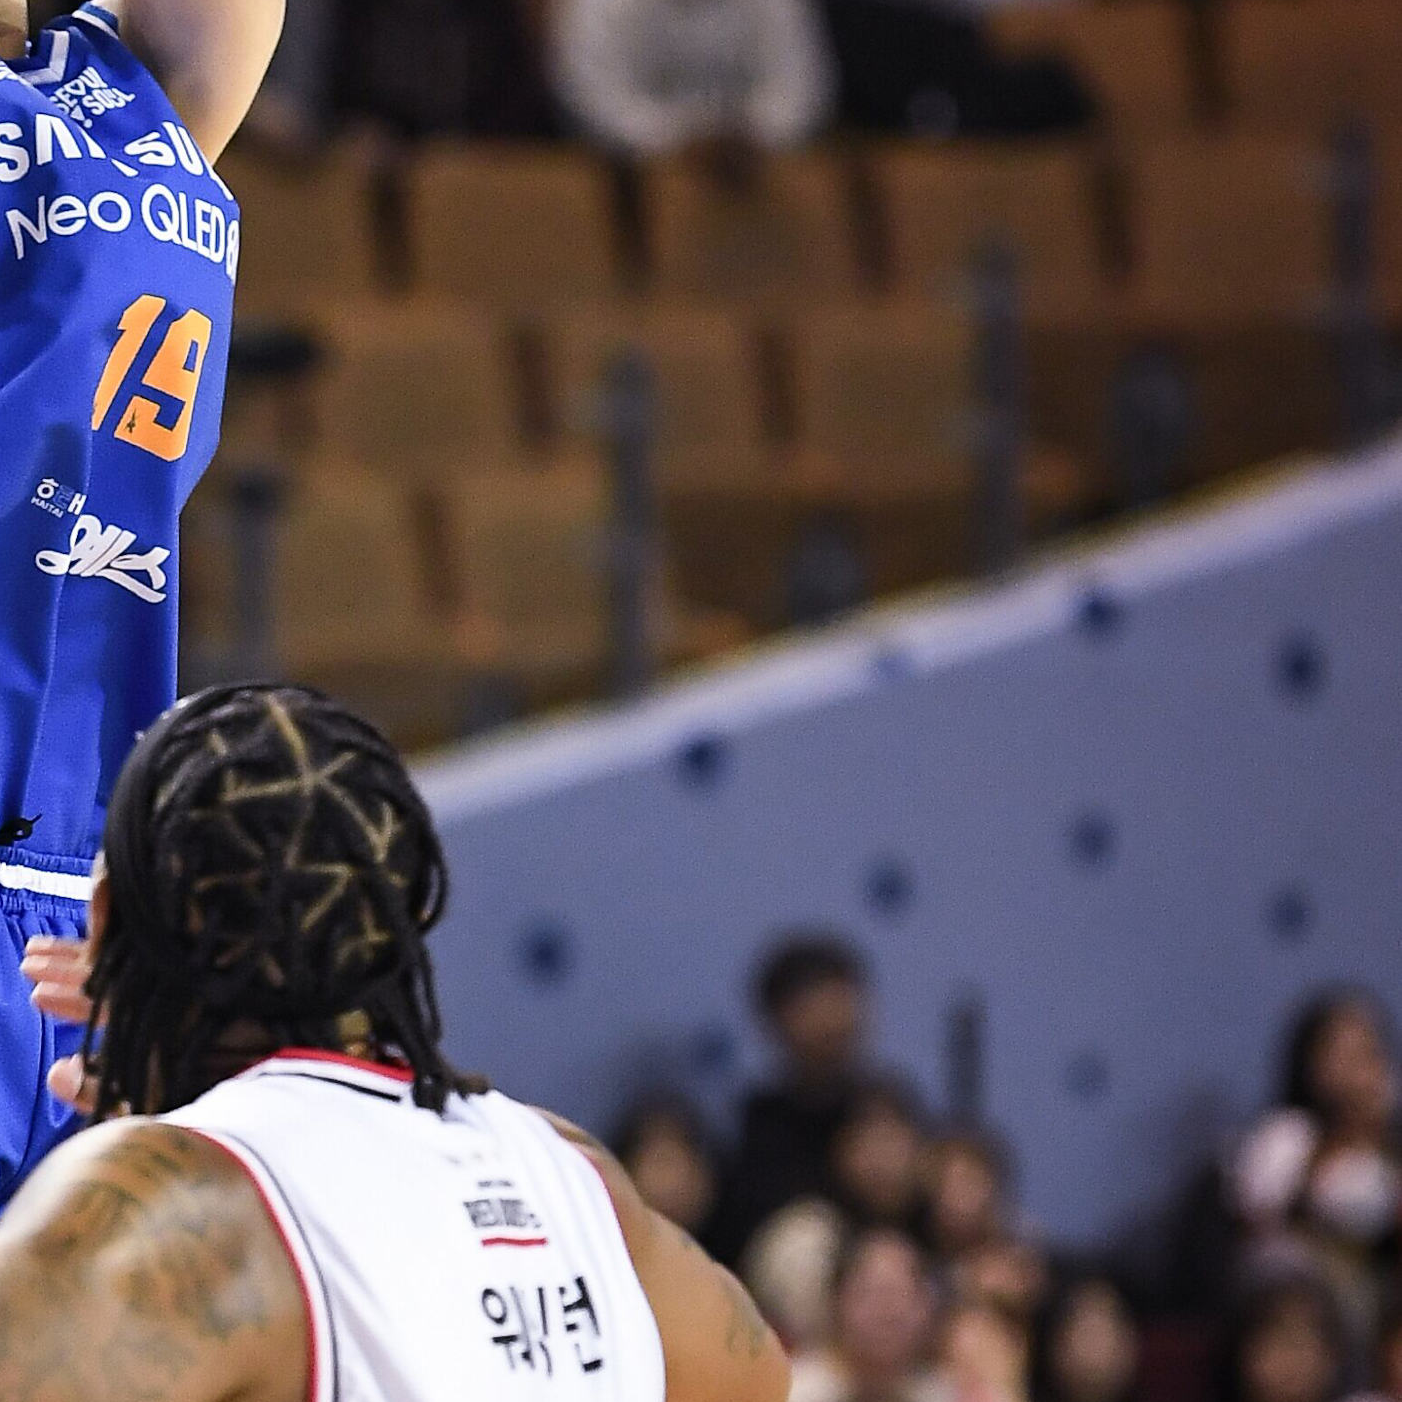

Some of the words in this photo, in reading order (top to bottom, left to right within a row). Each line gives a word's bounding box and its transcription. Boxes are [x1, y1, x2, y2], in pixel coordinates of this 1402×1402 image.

[6, 191, 132, 260] Neo
[141, 183, 226, 264] QLED
[91, 294, 212, 462] 19
